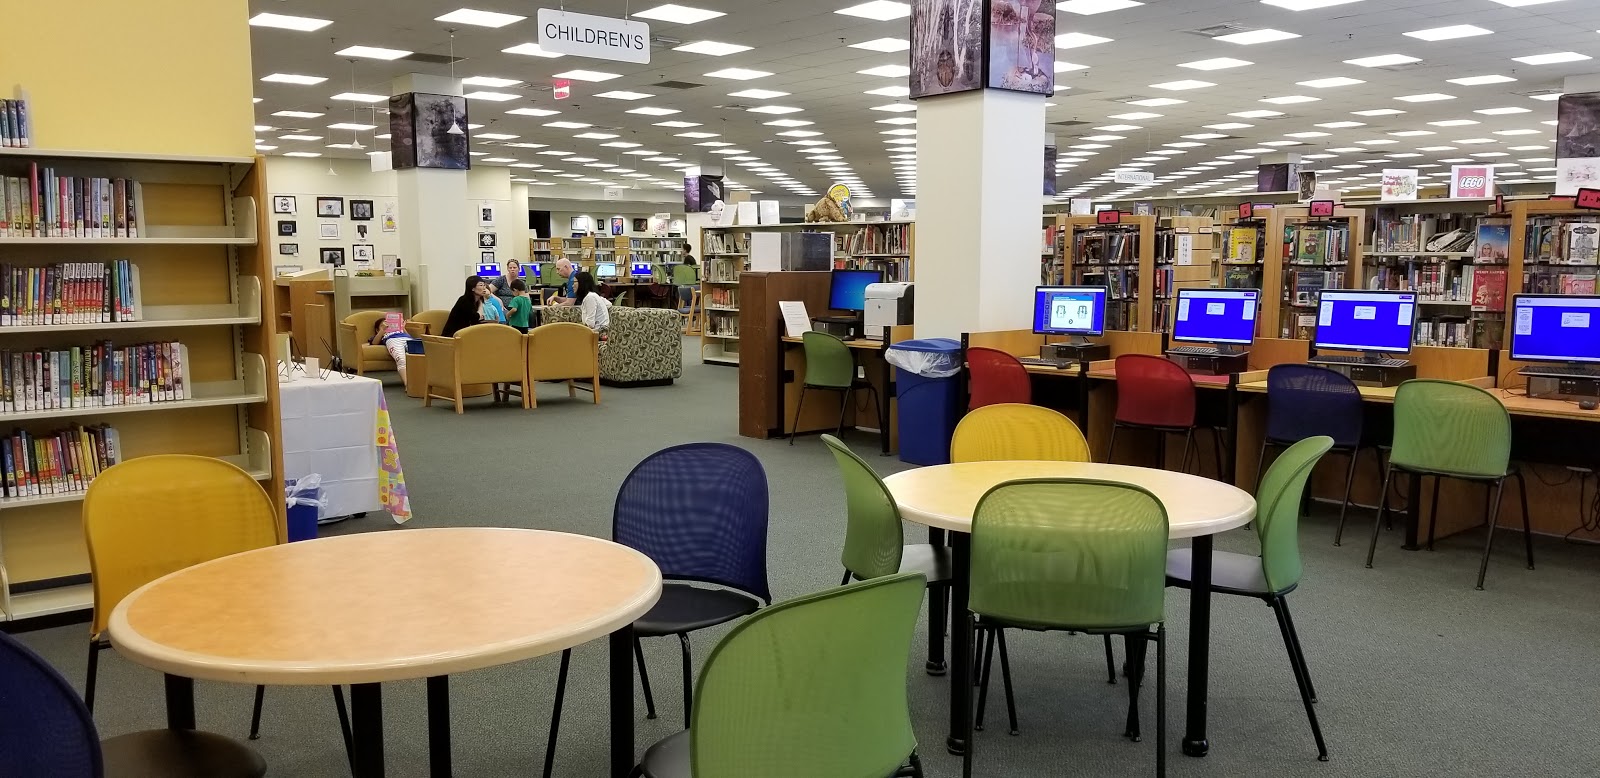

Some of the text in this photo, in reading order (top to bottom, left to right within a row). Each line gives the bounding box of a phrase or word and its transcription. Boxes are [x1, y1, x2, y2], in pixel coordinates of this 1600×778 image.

[545, 23, 644, 50] CHILDREN'S
[1117, 174, 1151, 182] INTERNATIONAL
[1460, 177, 1484, 188] LEGO
